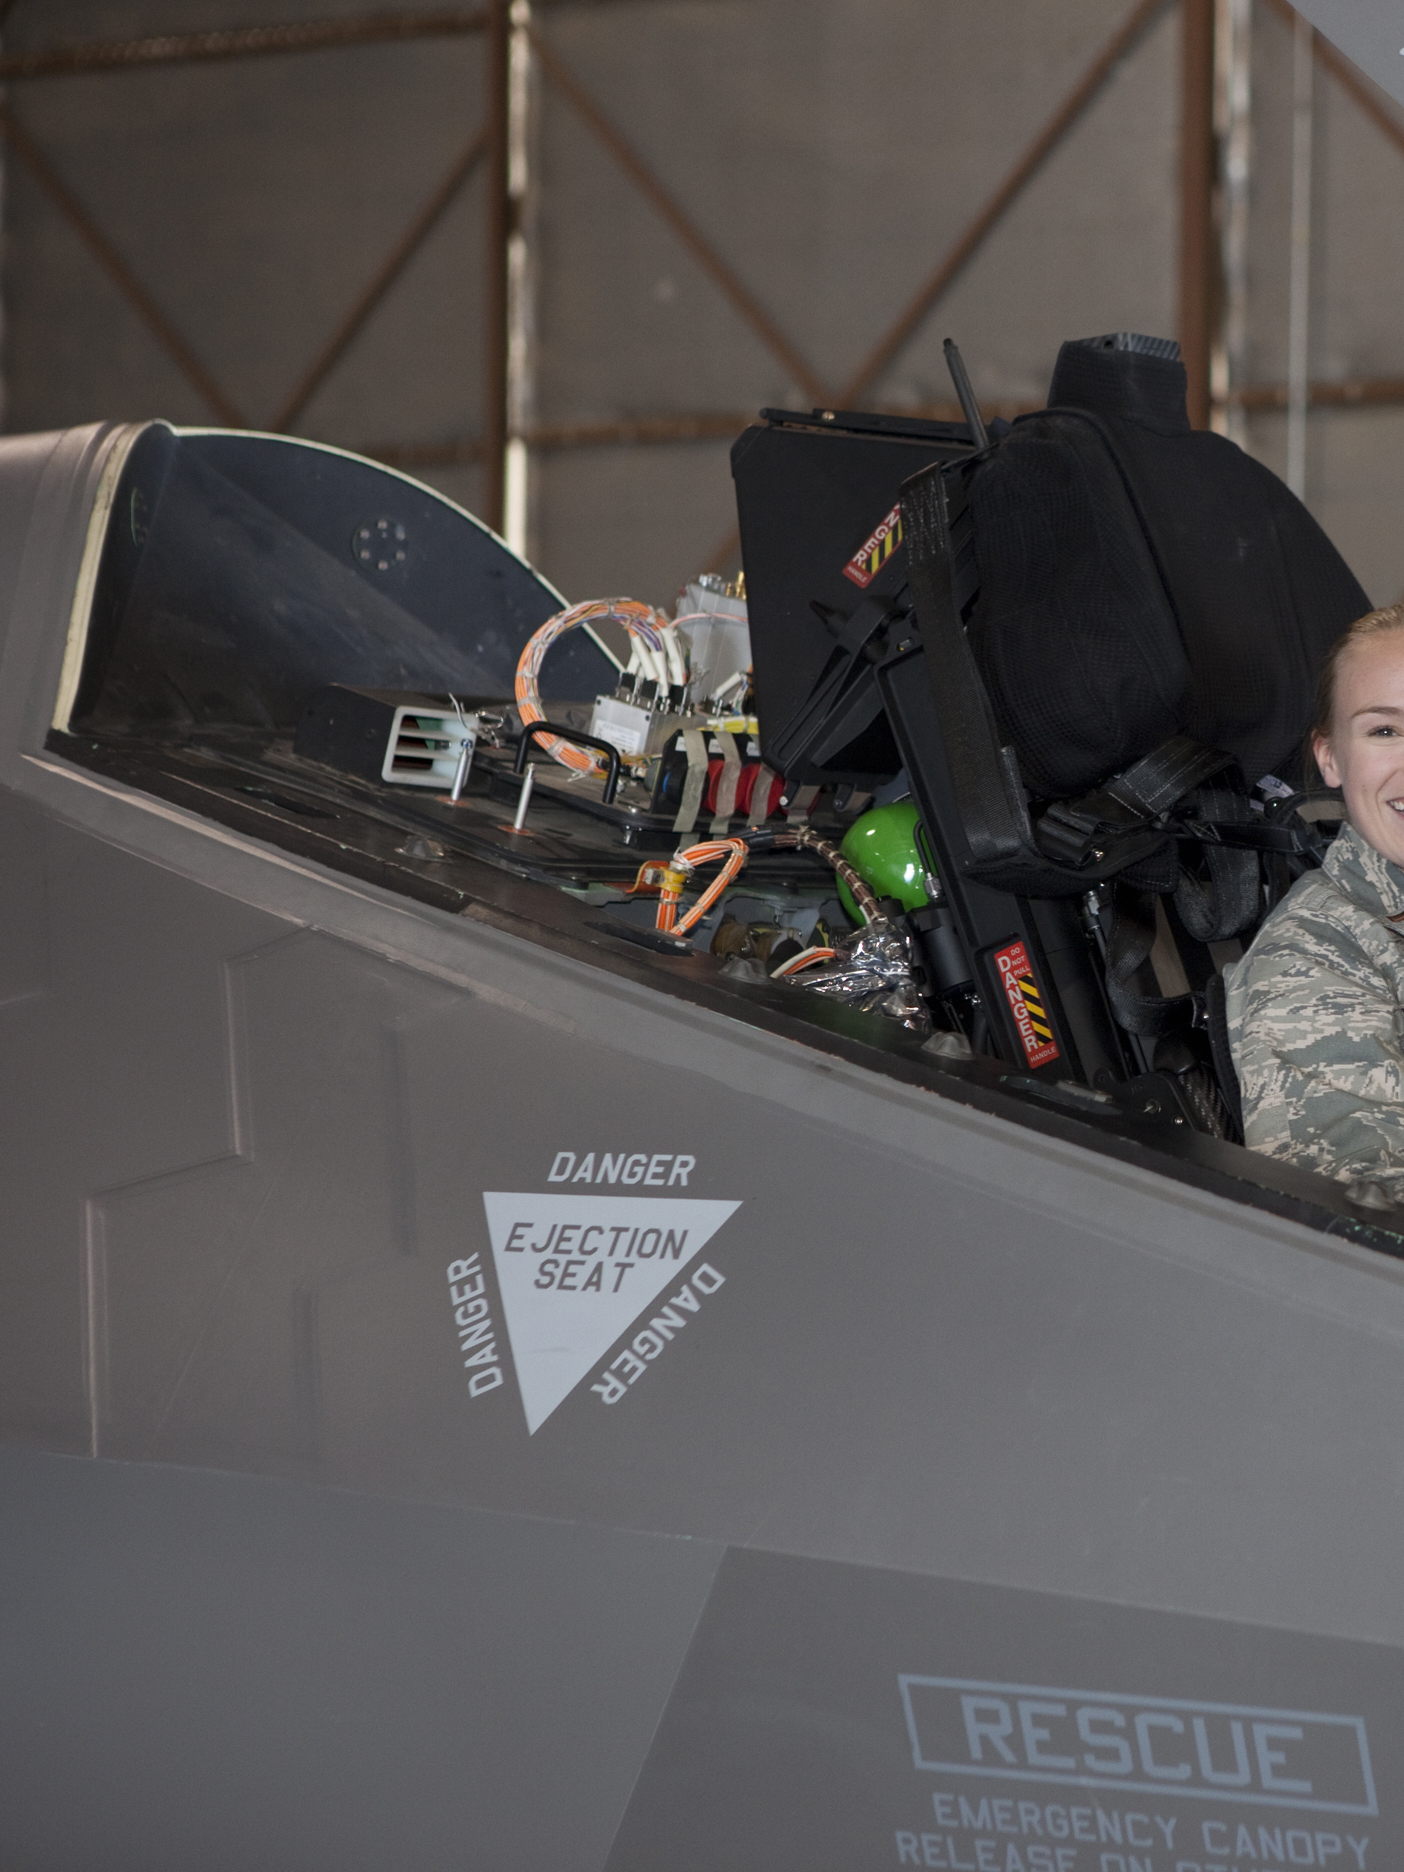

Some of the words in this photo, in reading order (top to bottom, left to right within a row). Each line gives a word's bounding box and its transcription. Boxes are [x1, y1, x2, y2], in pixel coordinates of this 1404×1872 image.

[853, 504, 900, 566] NGER
[847, 565, 868, 583] HANDLE
[1010, 947, 1021, 956] DO
[1012, 955, 1026, 966] NOT
[1013, 965, 1030, 976] PULL
[998, 955, 1039, 1052] DANGER
[1030, 1046, 1056, 1062] HANDLE
[547, 1152, 696, 1186] DANGER
[504, 1222, 689, 1260] EJECTION
[533, 1258, 635, 1293] SEAT
[446, 1252, 504, 1398] DANGER
[590, 1262, 726, 1404] DANGER
[960, 1694, 1313, 1794] RESCUE
[932, 1792, 1177, 1850] EMERGENCY
[1201, 1820, 1369, 1870] CANOPY
[895, 1830, 1078, 1872] RELEASE
